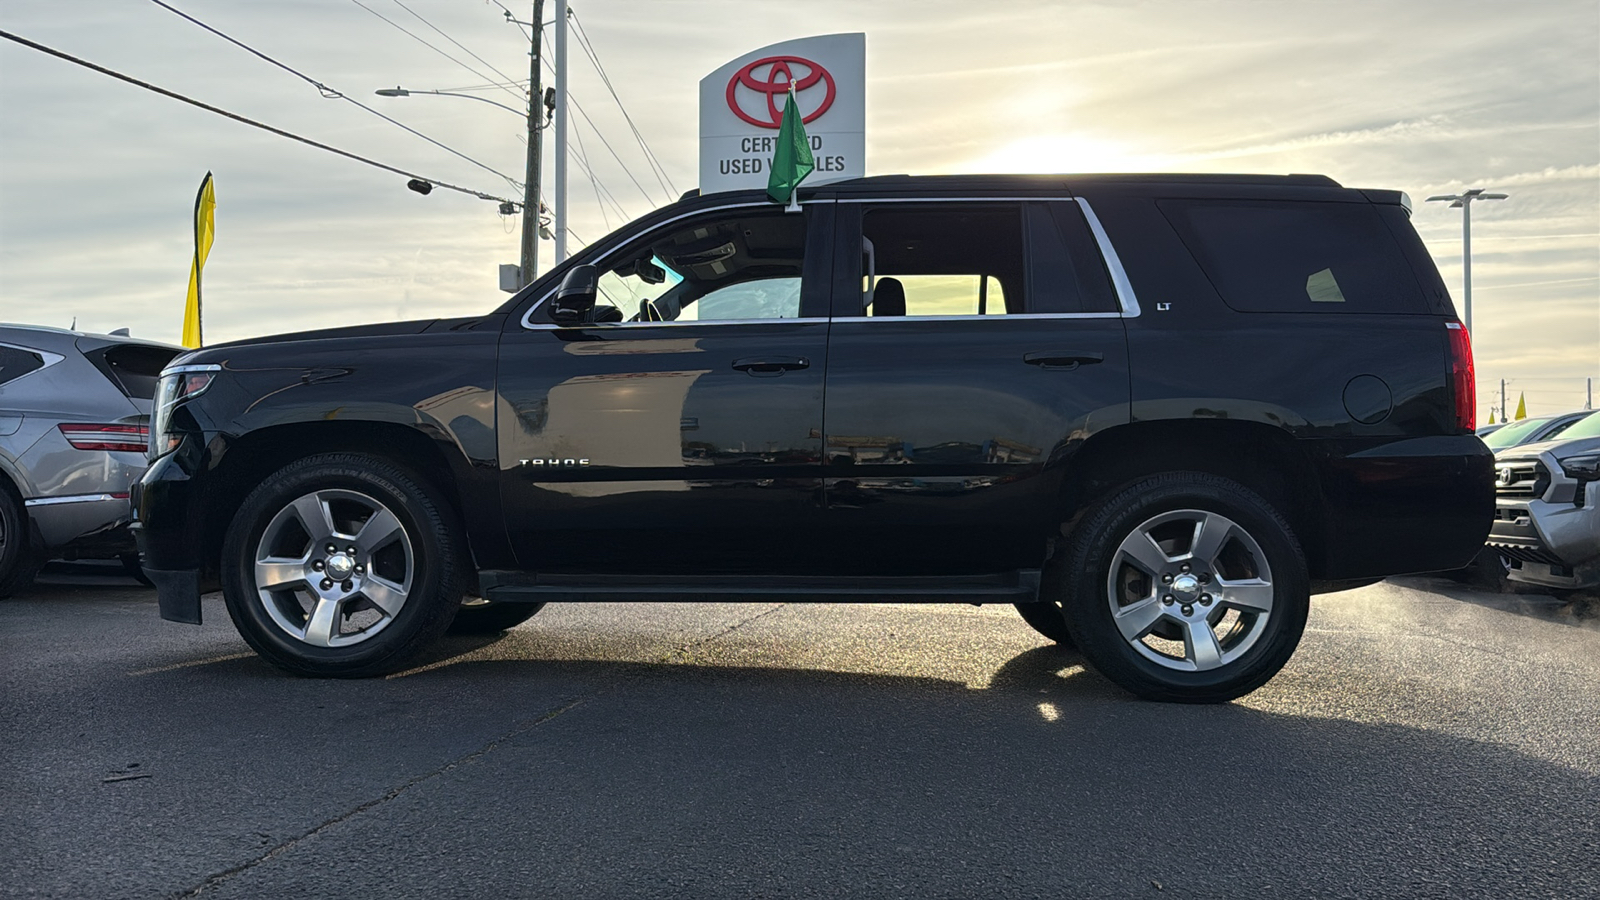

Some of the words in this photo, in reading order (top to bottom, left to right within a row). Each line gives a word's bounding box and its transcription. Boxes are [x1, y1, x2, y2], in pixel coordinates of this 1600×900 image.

[741, 135, 822, 153] CERTD
[720, 158, 762, 175] USED
[1156, 302, 1172, 311] LT
[519, 458, 590, 467] TAHOE
